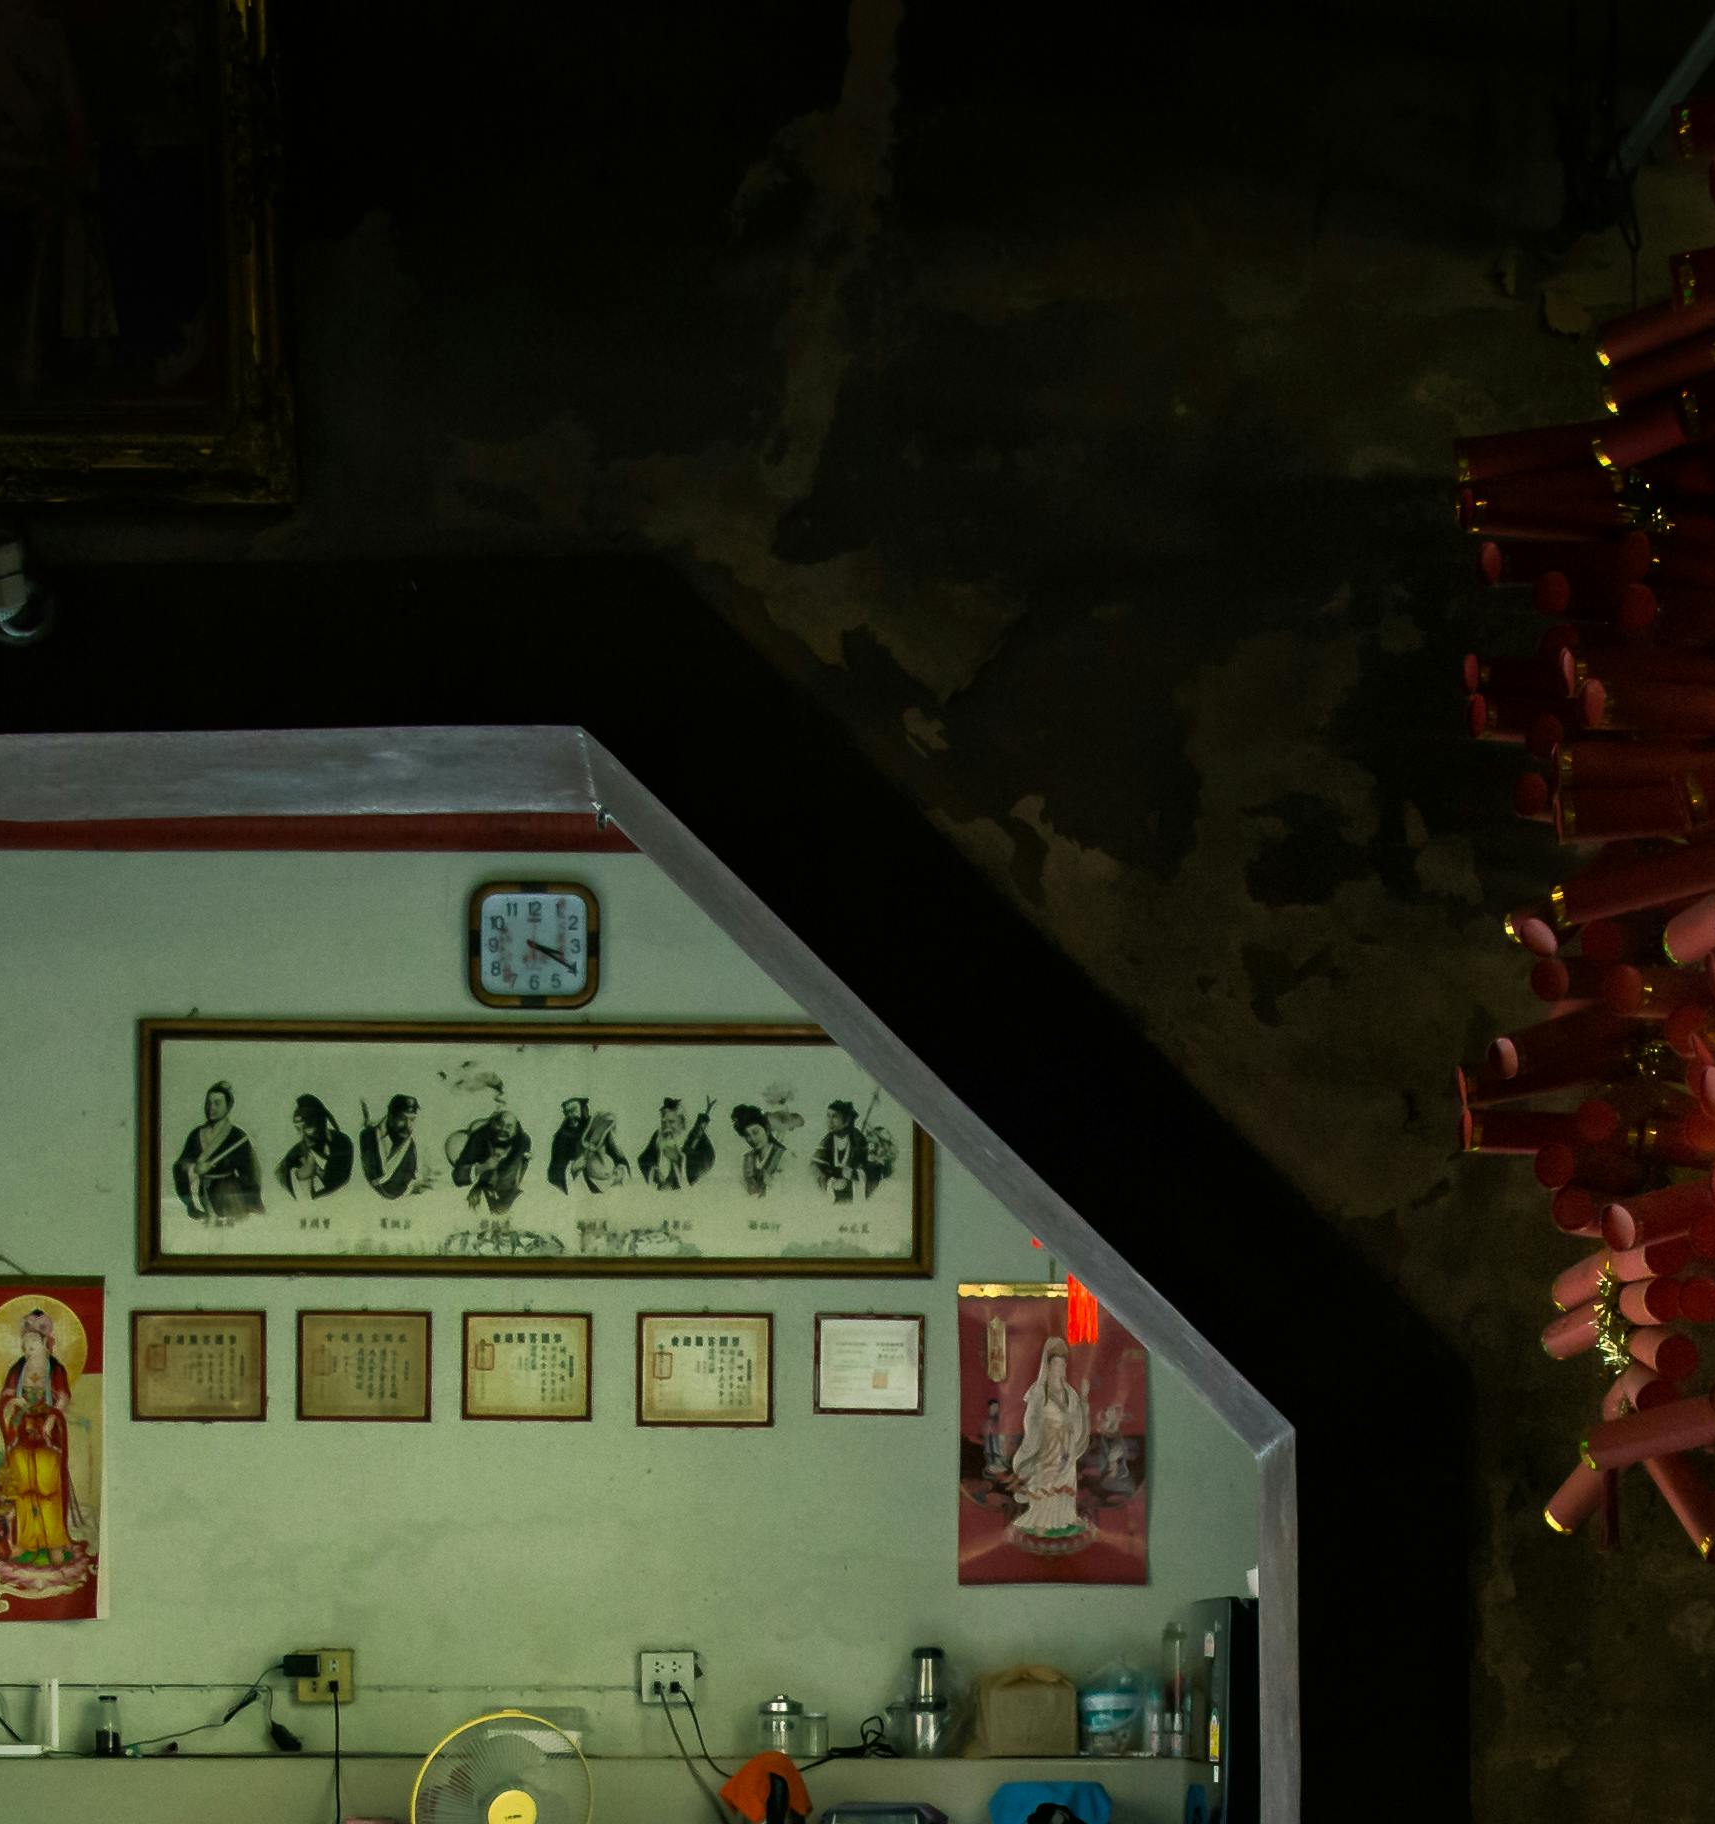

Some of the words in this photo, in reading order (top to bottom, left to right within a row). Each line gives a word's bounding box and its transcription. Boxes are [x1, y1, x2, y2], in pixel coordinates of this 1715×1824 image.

[506, 902, 518, 916] 11
[528, 901, 541, 916] 12
[490, 915, 504, 929] 10
[568, 916, 578, 930] 2
[488, 938, 499, 953] 9
[570, 939, 581, 954] 3
[491, 961, 501, 976] 8
[529, 975, 539, 990] 6
[551, 973, 561, 988] 5
